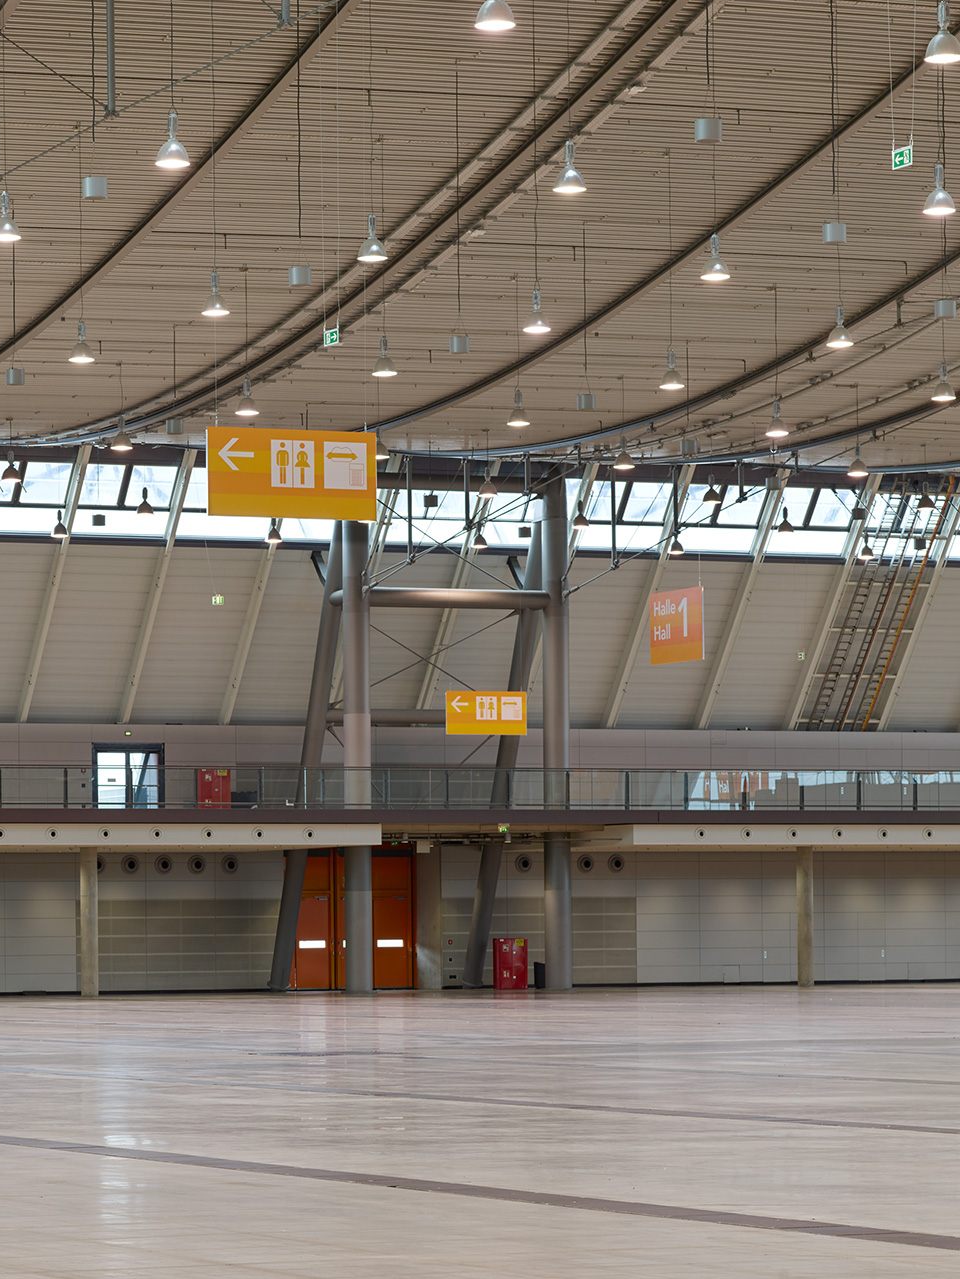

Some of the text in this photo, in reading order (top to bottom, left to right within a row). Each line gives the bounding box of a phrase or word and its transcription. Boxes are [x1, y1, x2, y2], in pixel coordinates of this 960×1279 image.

[653, 597, 688, 637] Halle 1
[653, 623, 671, 641] Hall
